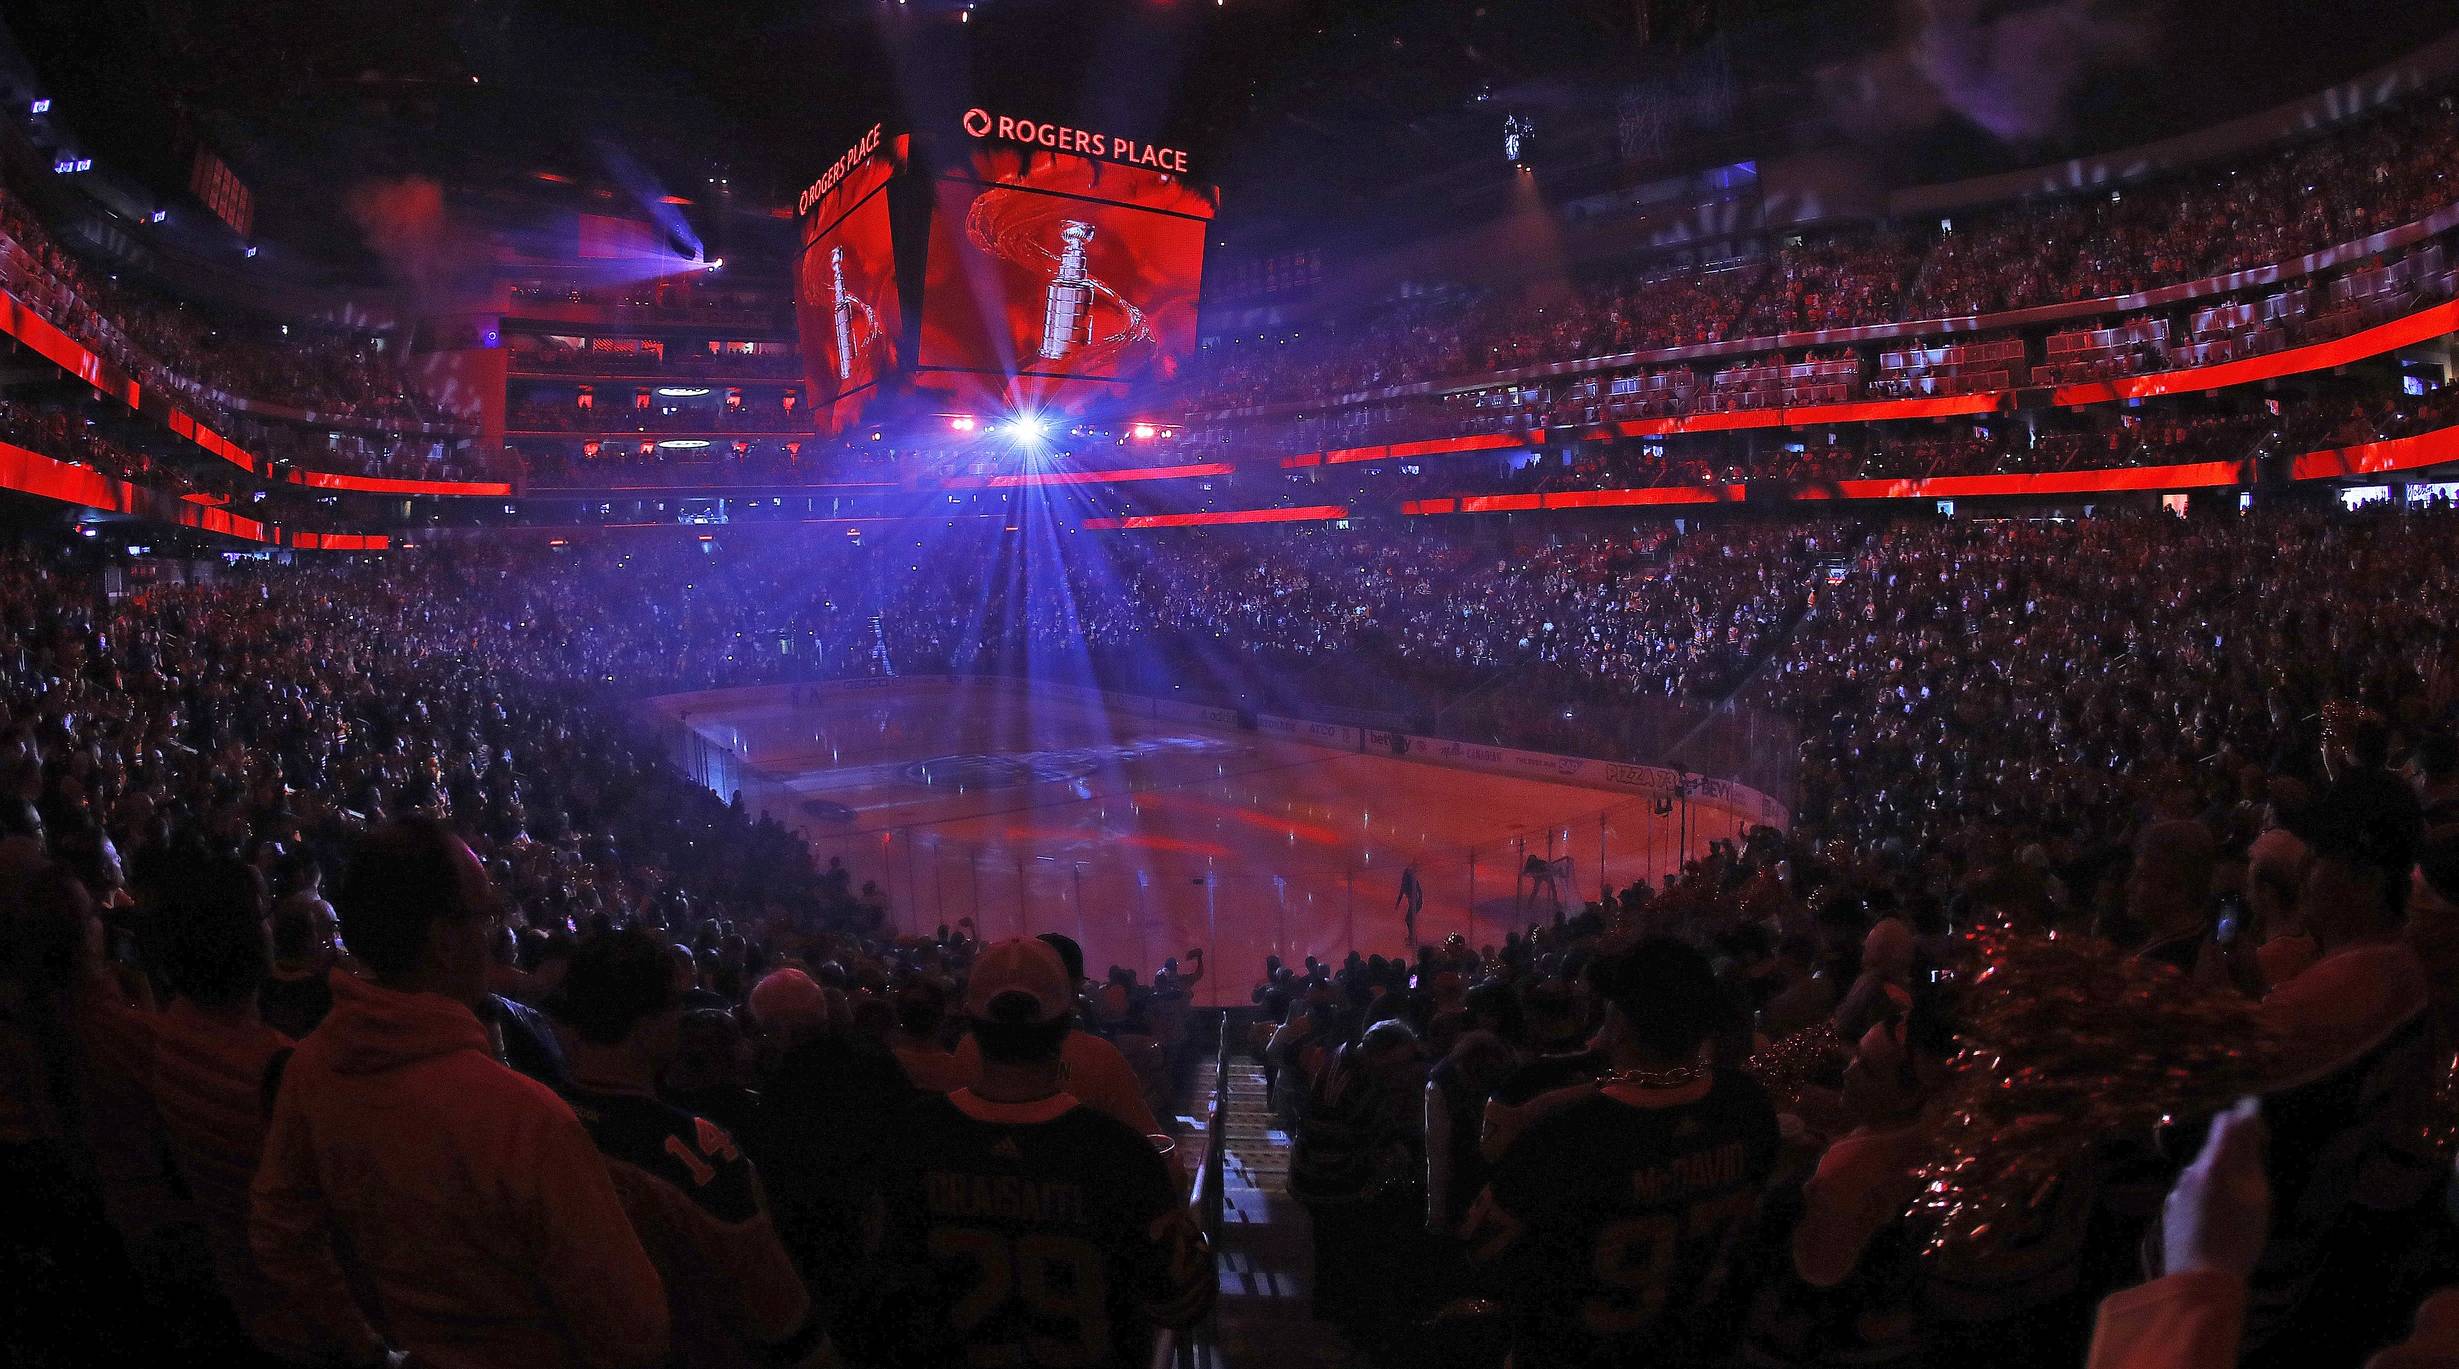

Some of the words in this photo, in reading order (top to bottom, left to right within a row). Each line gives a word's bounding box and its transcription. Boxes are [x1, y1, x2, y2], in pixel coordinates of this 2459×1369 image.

[809, 155, 846, 206] ROGERS
[846, 122, 881, 171] PLACE
[999, 115, 1105, 156] ROGERS
[1114, 137, 1189, 173] PLACE
[1606, 762, 1655, 788] PIZZA
[1656, 769, 1677, 792] 73
[663, 1115, 740, 1186] 14
[927, 1227, 1106, 1367] 29
[1583, 1191, 1762, 1331] 97
